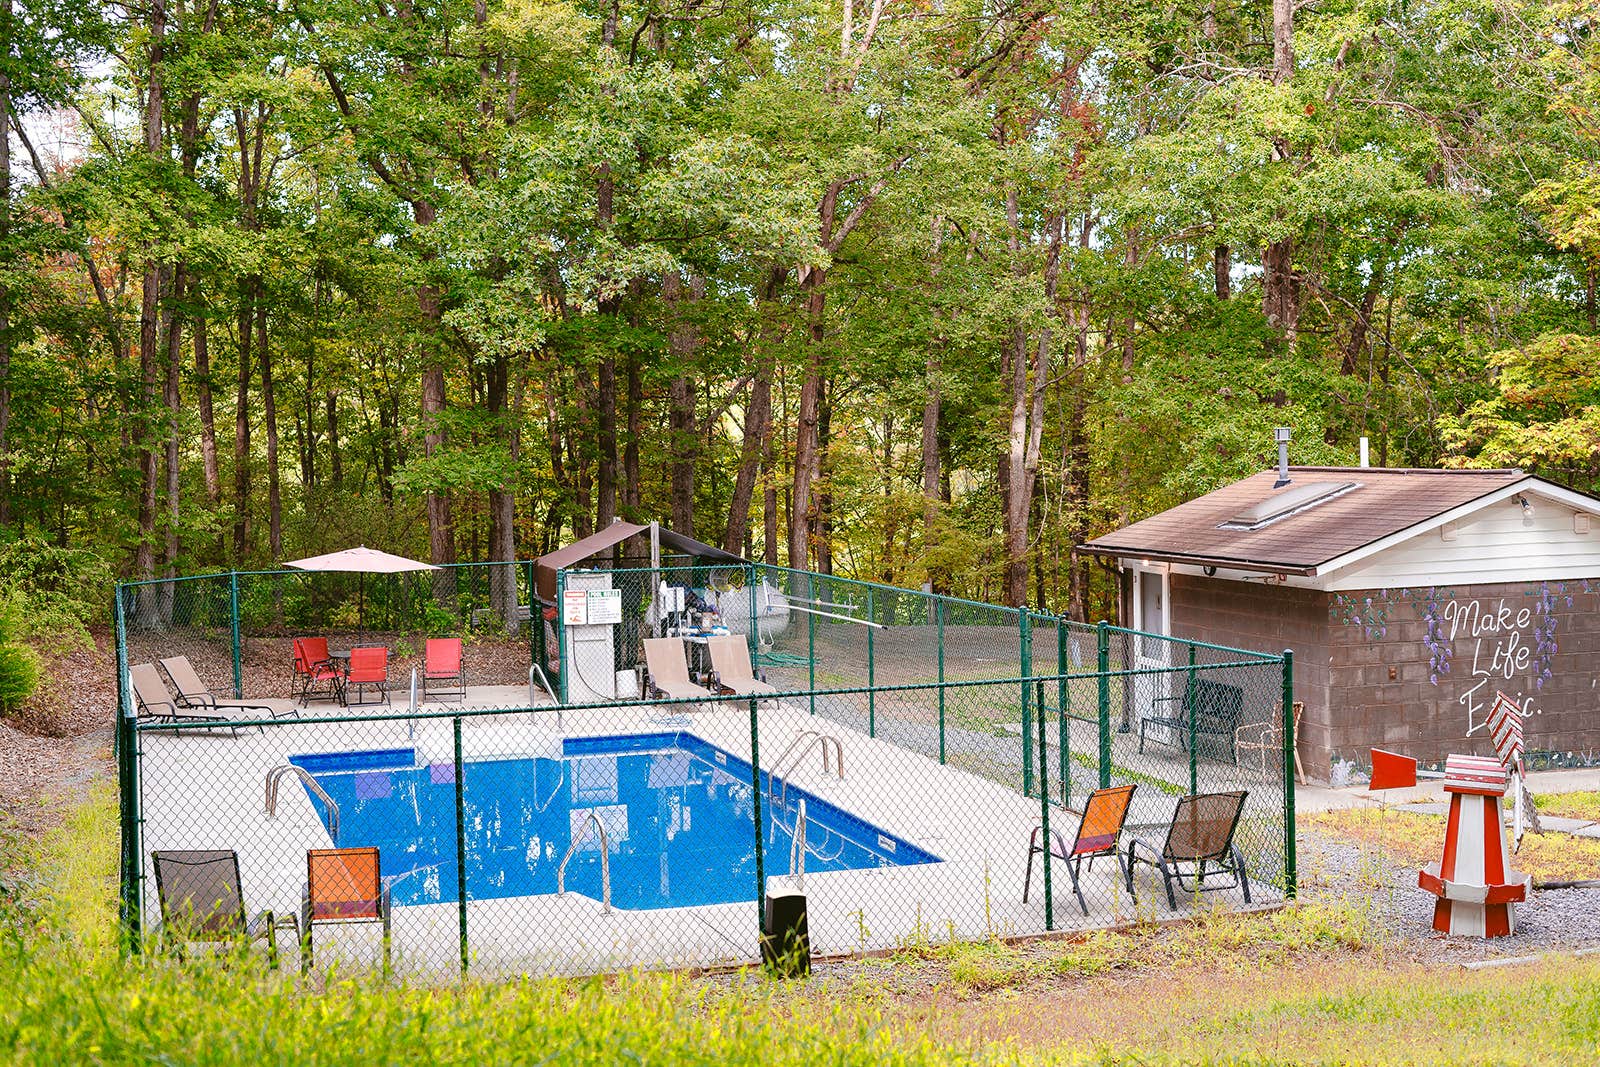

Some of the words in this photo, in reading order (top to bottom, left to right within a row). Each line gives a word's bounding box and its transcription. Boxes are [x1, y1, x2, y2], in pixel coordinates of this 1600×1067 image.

[1445, 599, 1531, 641] Make
[1472, 631, 1530, 680] Life
[1460, 678, 1542, 738] Eic.
